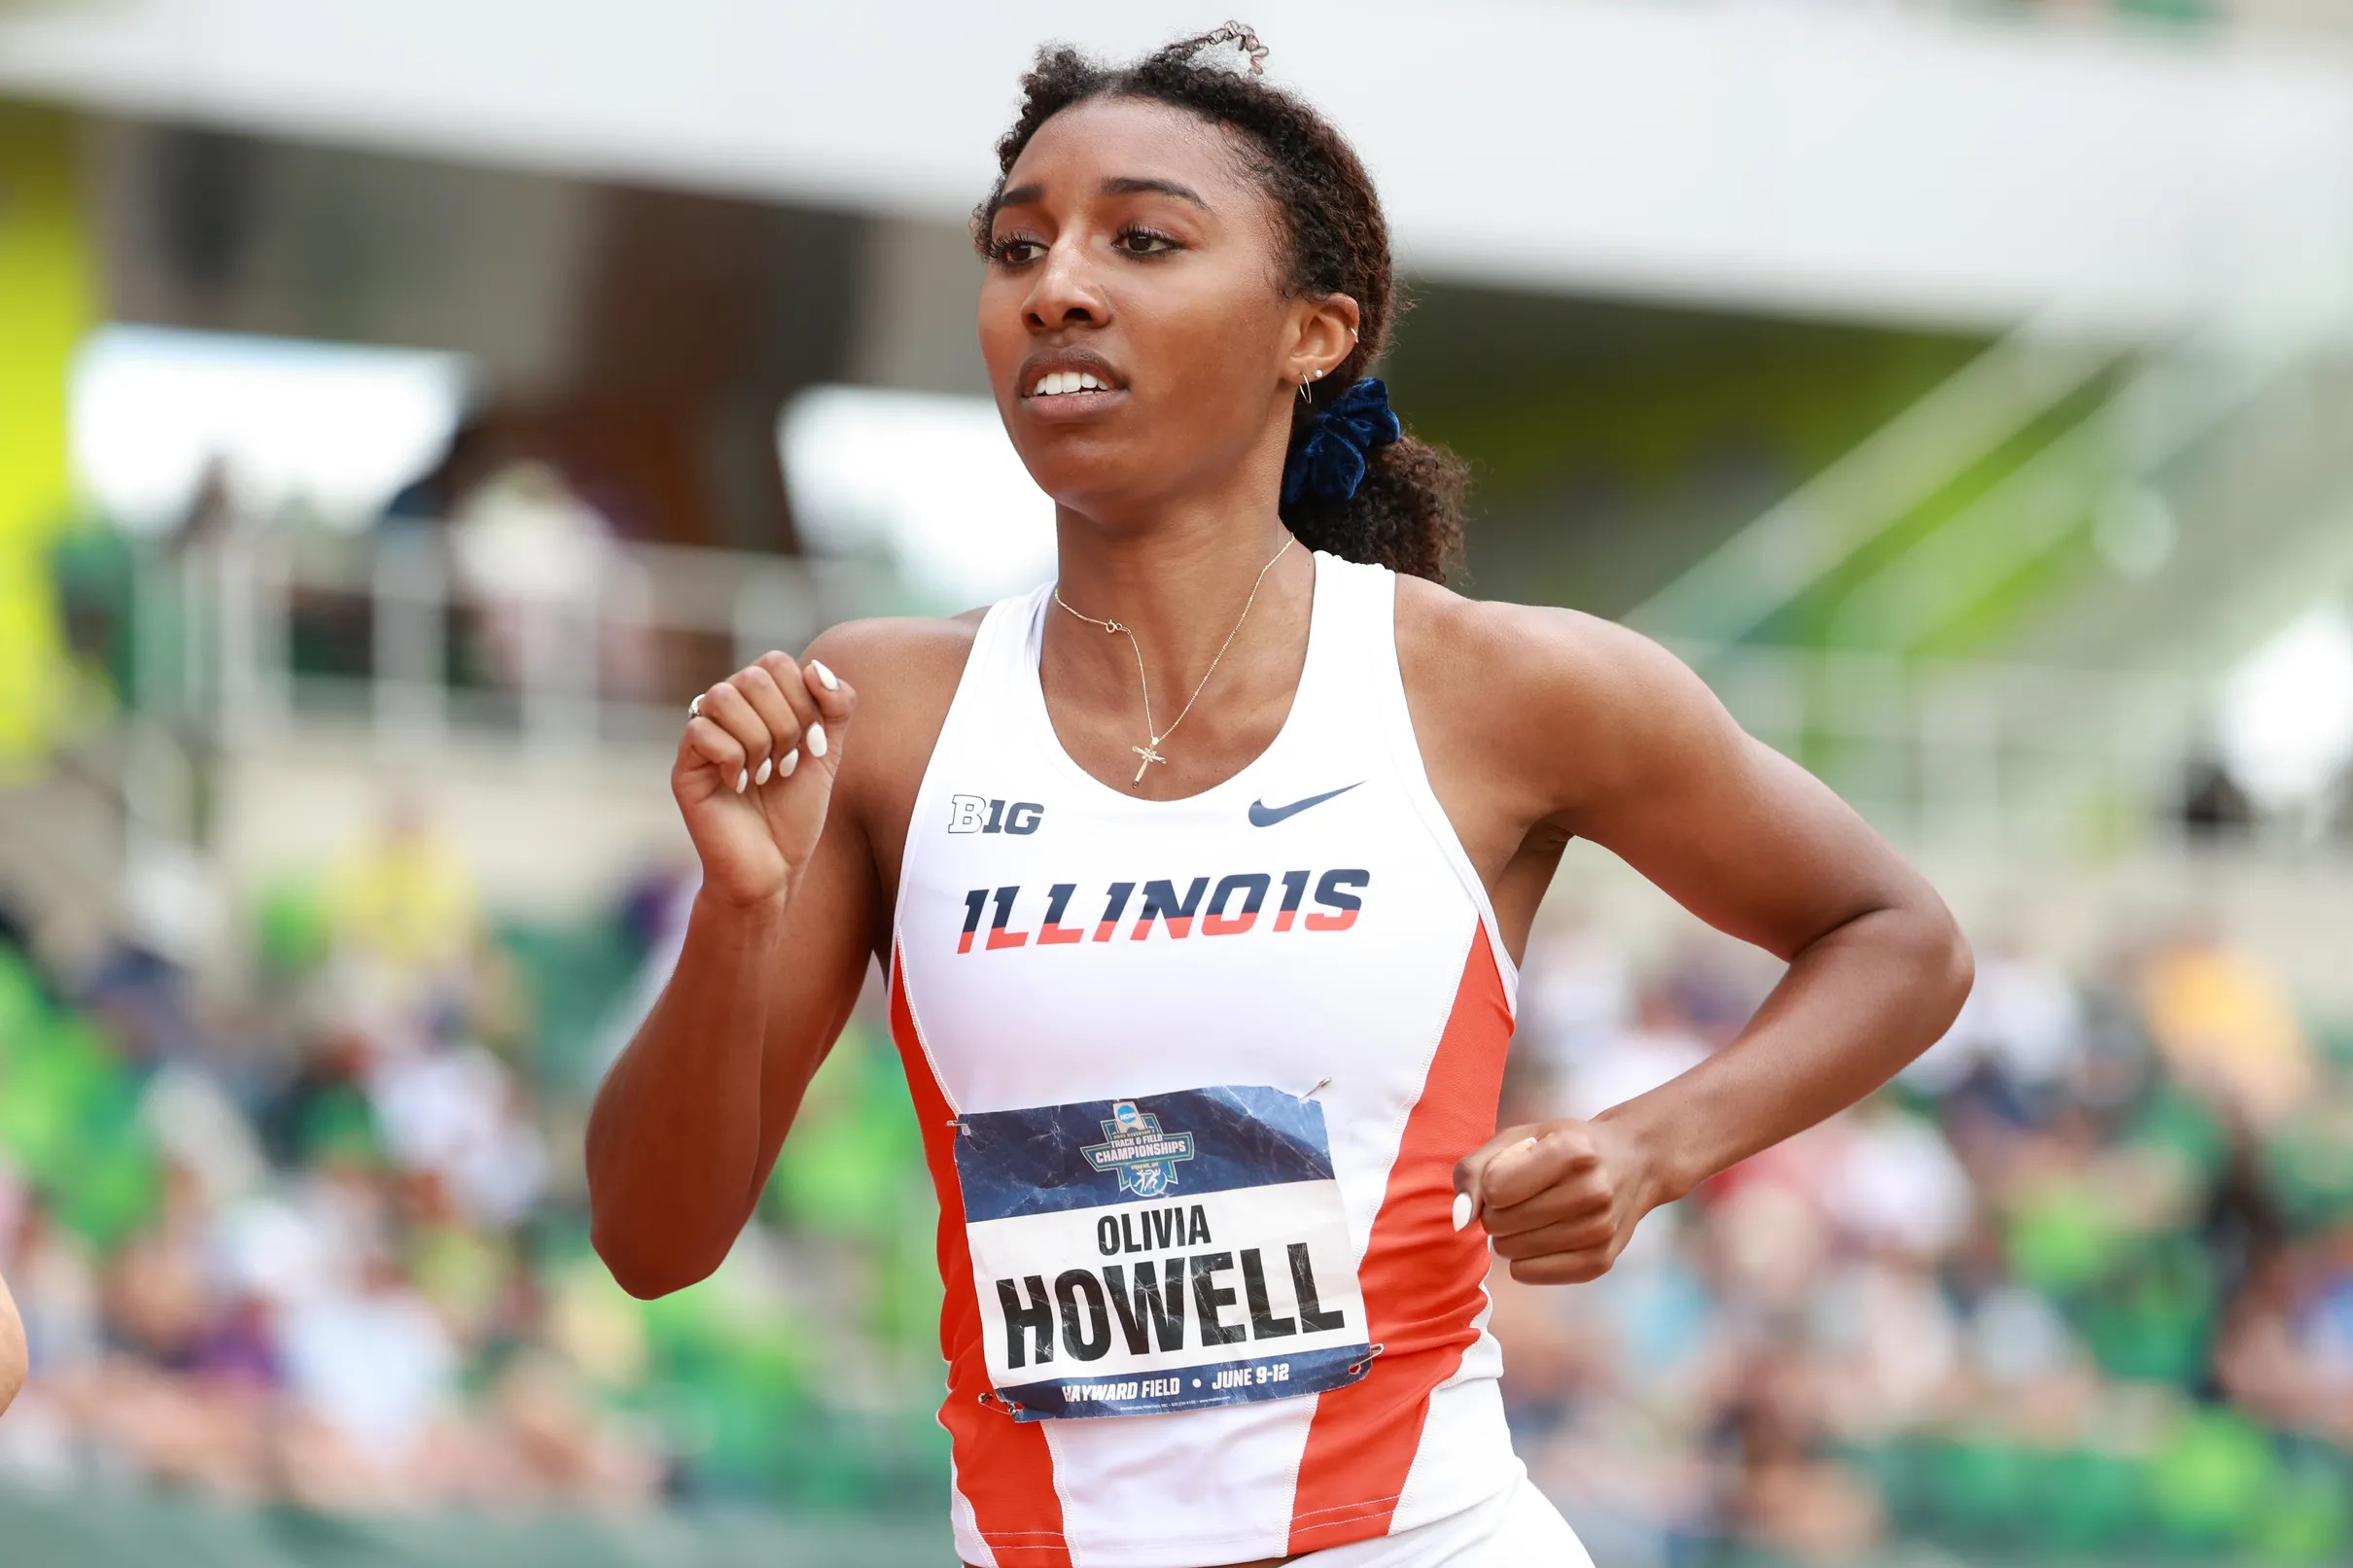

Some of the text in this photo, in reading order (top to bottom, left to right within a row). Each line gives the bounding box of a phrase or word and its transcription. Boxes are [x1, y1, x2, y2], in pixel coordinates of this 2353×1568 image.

[957, 869, 1370, 955] ILLINOIS
[1095, 1140, 1186, 1164] CHAMPIONSHIPS
[1110, 1137, 1135, 1148] TRACK
[1143, 1133, 1163, 1143] FIELD
[1097, 1204, 1212, 1256] OLIVIA
[996, 1242, 1346, 1370] HOWELL
[1141, 1377, 1180, 1399] FIELD
[1212, 1368, 1252, 1390] JUNE
[1256, 1363, 1290, 1384] 9-12
